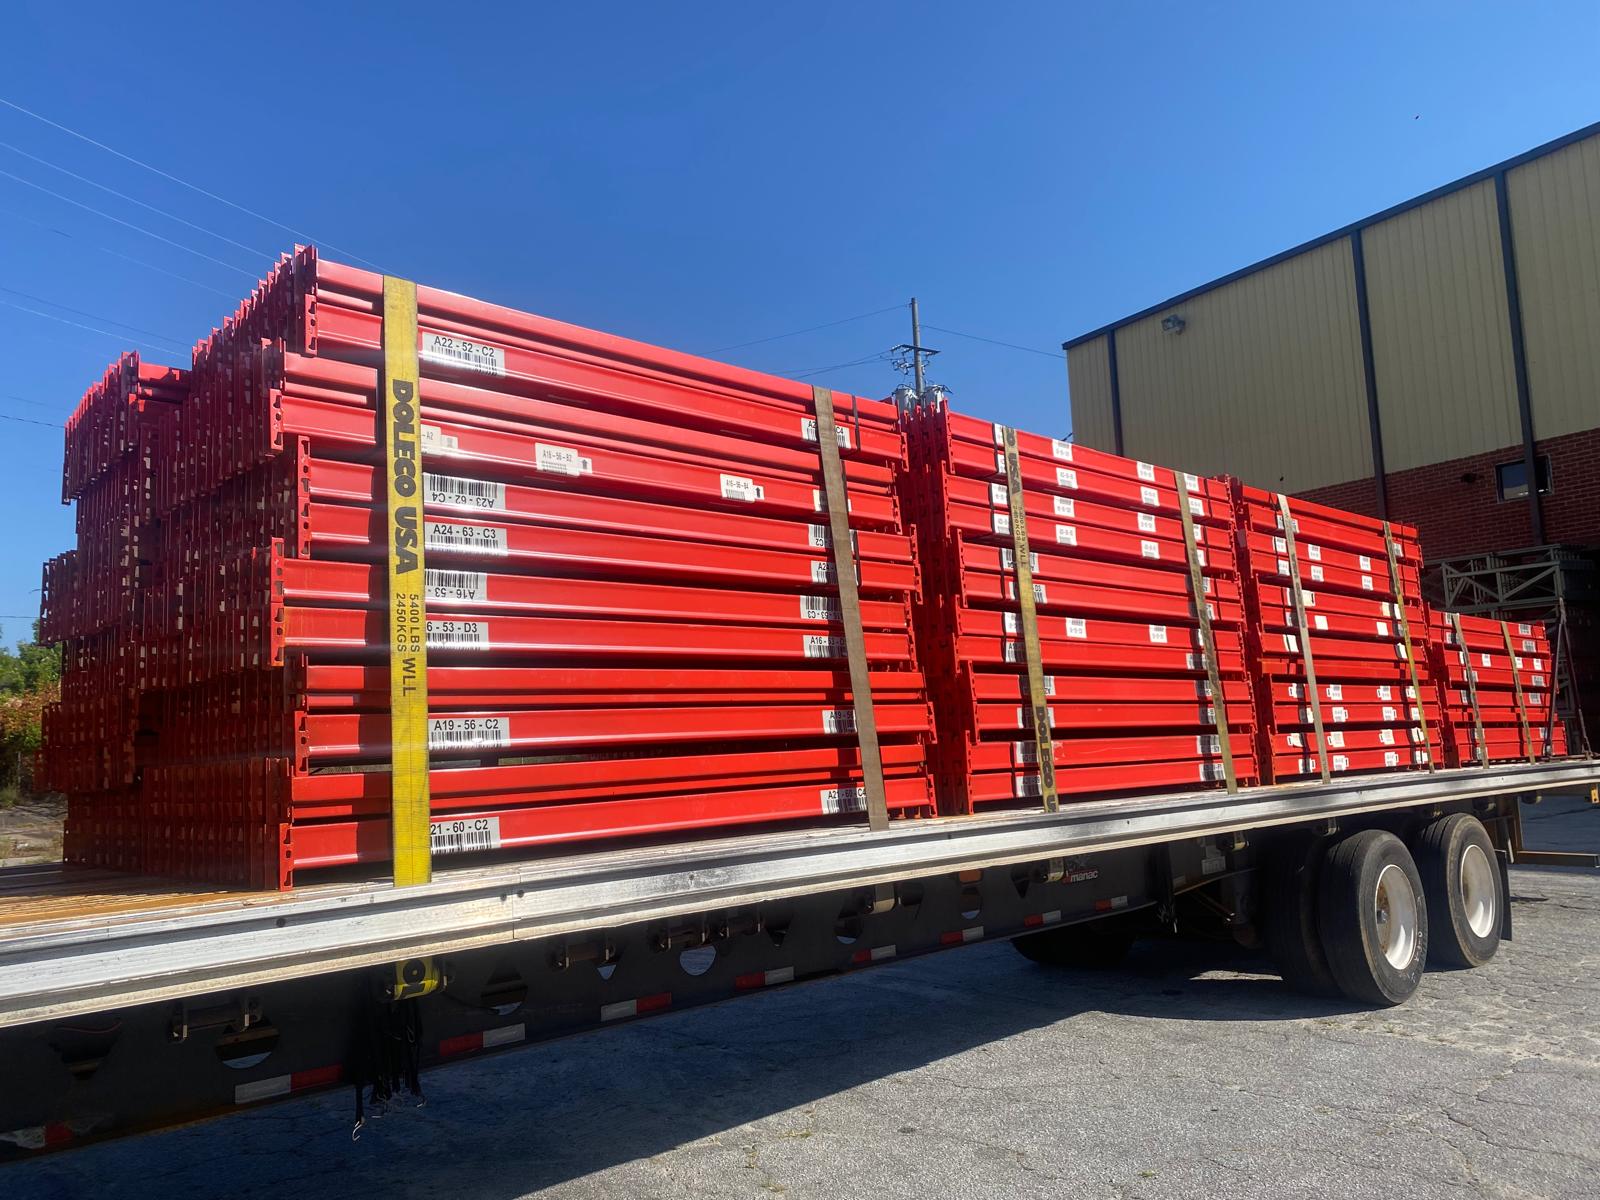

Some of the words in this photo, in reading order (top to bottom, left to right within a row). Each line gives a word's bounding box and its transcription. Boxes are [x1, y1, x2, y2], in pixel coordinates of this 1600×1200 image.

[434, 335, 453, 348] A22
[462, 341, 473, 353] 52
[481, 346, 495, 358] C2
[392, 378, 416, 497] DOLECO
[433, 524, 453, 535] A24
[462, 526, 474, 537] 63
[482, 528, 496, 539] C3
[394, 506, 419, 575] USA
[442, 621, 455, 633] 53
[464, 622, 478, 633] D3
[434, 719, 455, 731] A19
[464, 719, 476, 730] 56
[485, 718, 499, 730] C2
[452, 821, 465, 833] 60
[474, 819, 489, 831] C2
